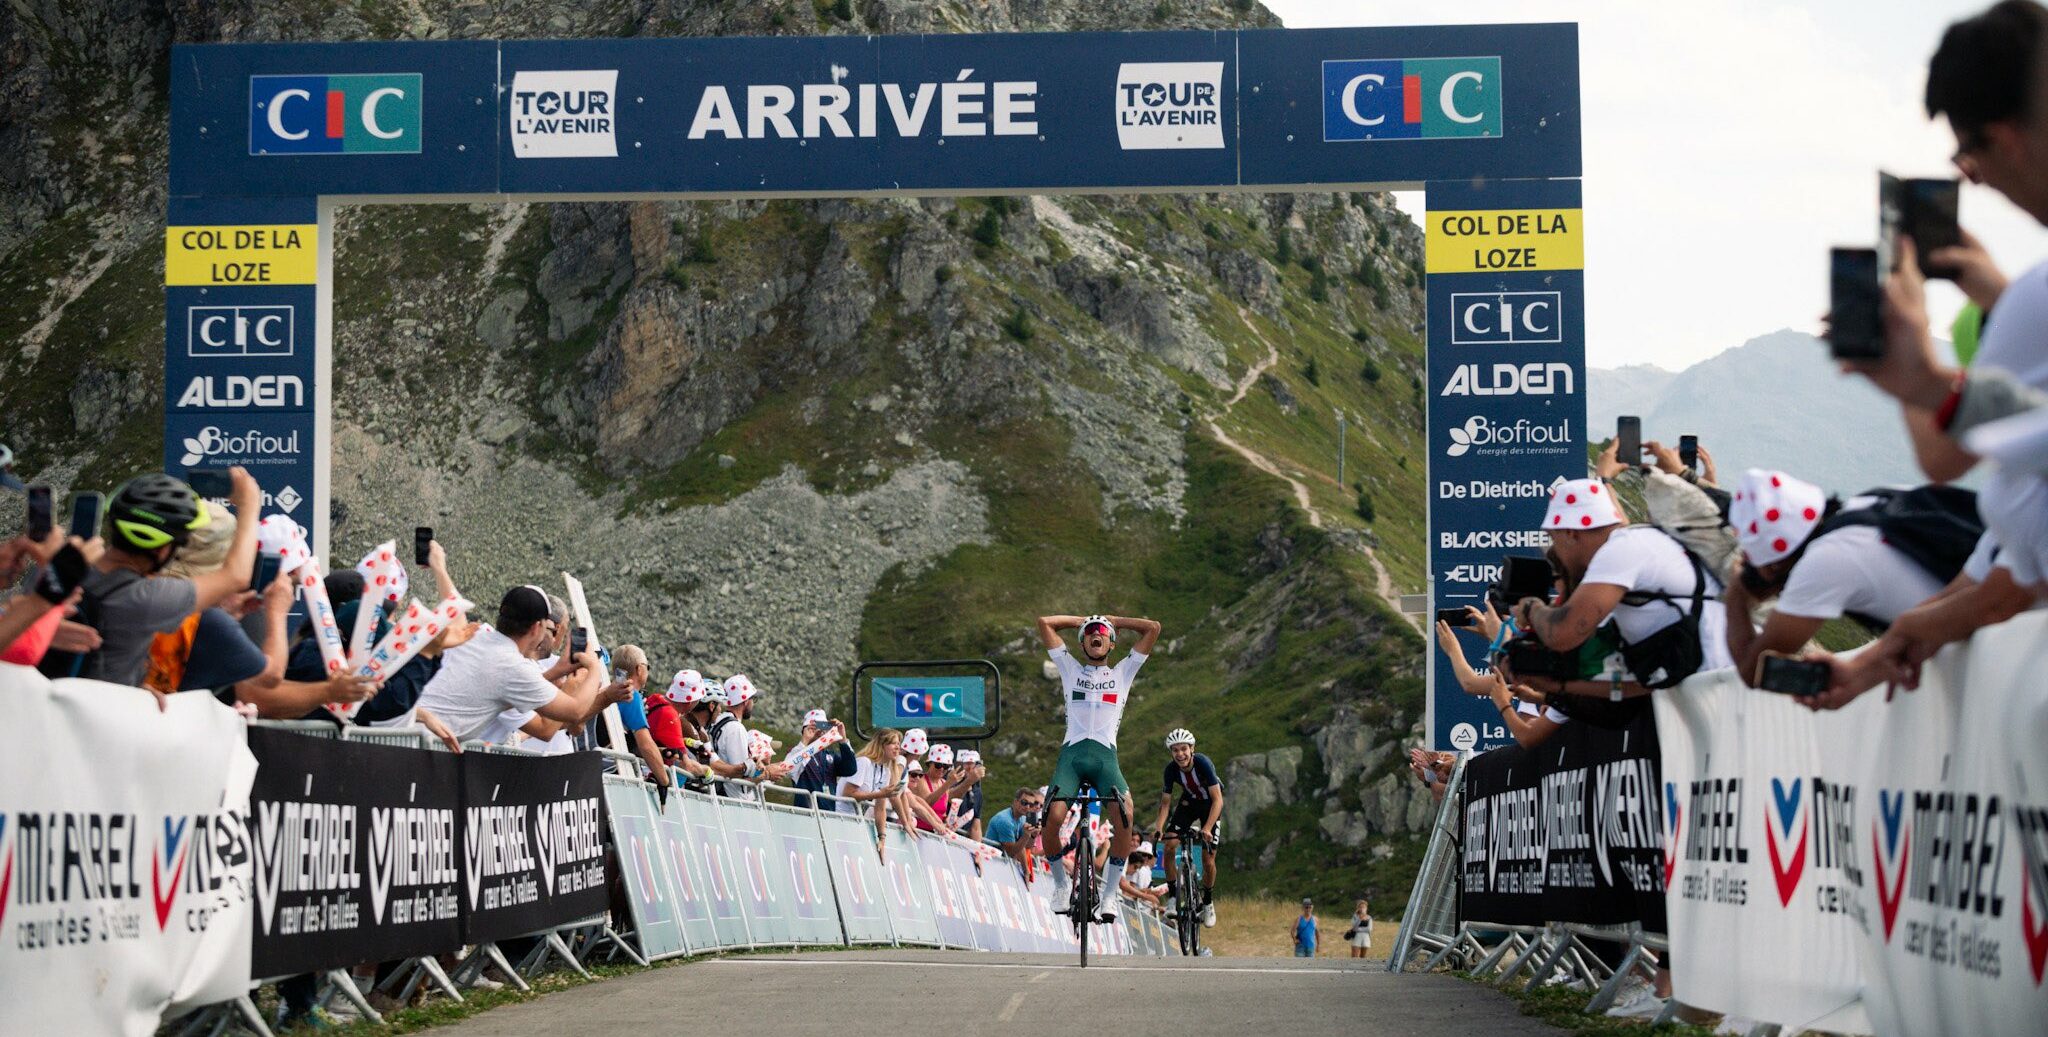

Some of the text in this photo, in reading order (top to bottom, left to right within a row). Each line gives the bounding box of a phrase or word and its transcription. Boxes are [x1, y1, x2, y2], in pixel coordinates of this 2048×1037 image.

[516, 90, 609, 115] TOUR
[687, 69, 1039, 139] ARRIVÉE
[1120, 82, 1216, 107] TOUR
[1341, 70, 1485, 125] CIC
[266, 87, 405, 140] CIC
[516, 117, 610, 135] L'AVENIR
[1121, 109, 1217, 127] L'AVENIR
[1442, 214, 1568, 236] COL DE LA
[182, 229, 302, 251] COL DE LA
[1475, 248, 1537, 269] LOZE
[211, 262, 271, 282] LOZE
[1463, 301, 1549, 334] CIC
[200, 315, 282, 347] CIC
[177, 375, 304, 408] ALDEN
[1440, 362, 1574, 397] ALDEN
[202, 426, 300, 455] Biofioul
[1466, 415, 1572, 446] Biofioul
[1440, 480, 1545, 499] De Dietrich
[901, 692, 956, 714] CIC
[1483, 722, 1505, 739] La
